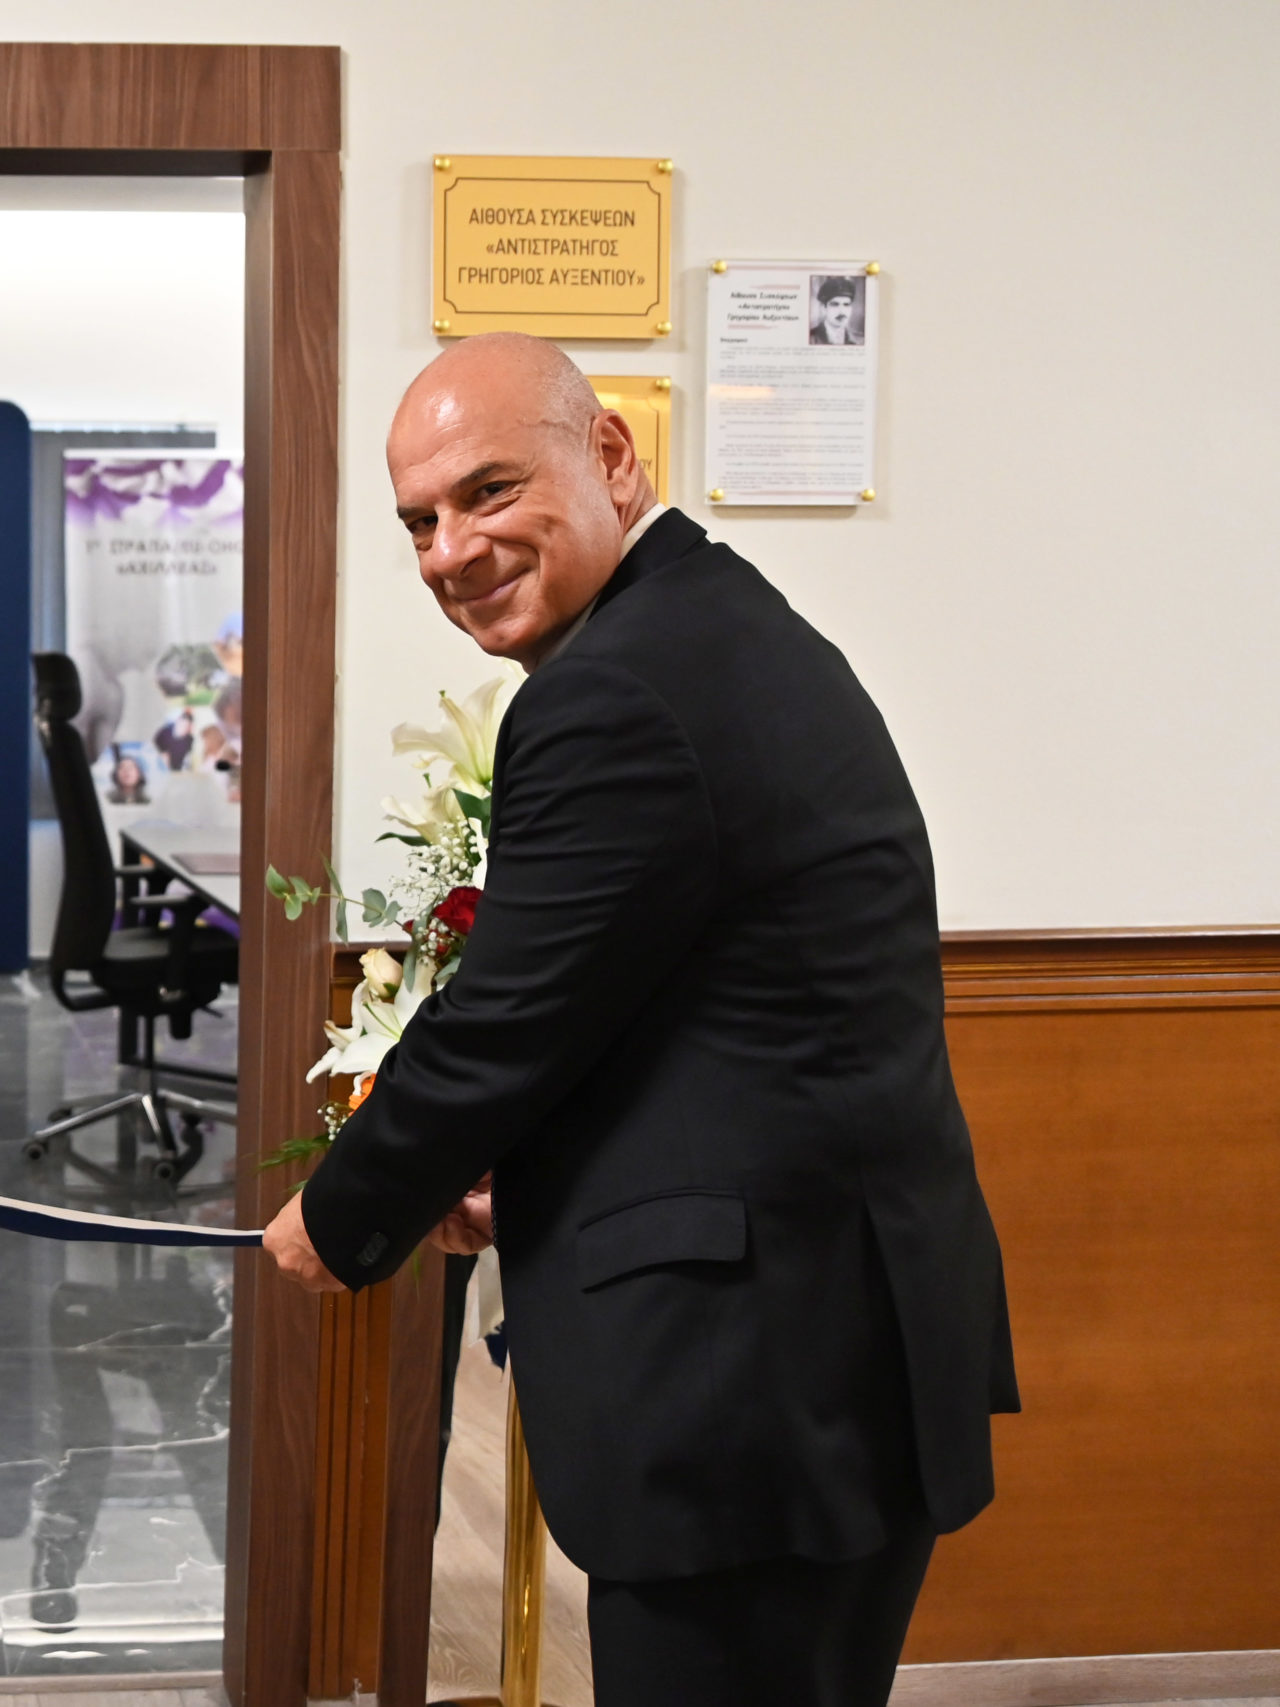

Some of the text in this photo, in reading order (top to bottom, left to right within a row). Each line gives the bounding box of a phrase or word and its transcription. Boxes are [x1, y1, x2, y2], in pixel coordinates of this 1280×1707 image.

[468, 208, 635, 227] ΑΙΘΟΥΣΑ ΣΥΣΚΕΨΕΩΝ
[486, 238, 619, 256] «ΑΝΤΙΣΤΡΑΤΗΓΟΣ
[458, 267, 645, 286] ΓΡΗΓΟΡΙΟΣ ΑΥΞΕΝΤΙΟΥ»
